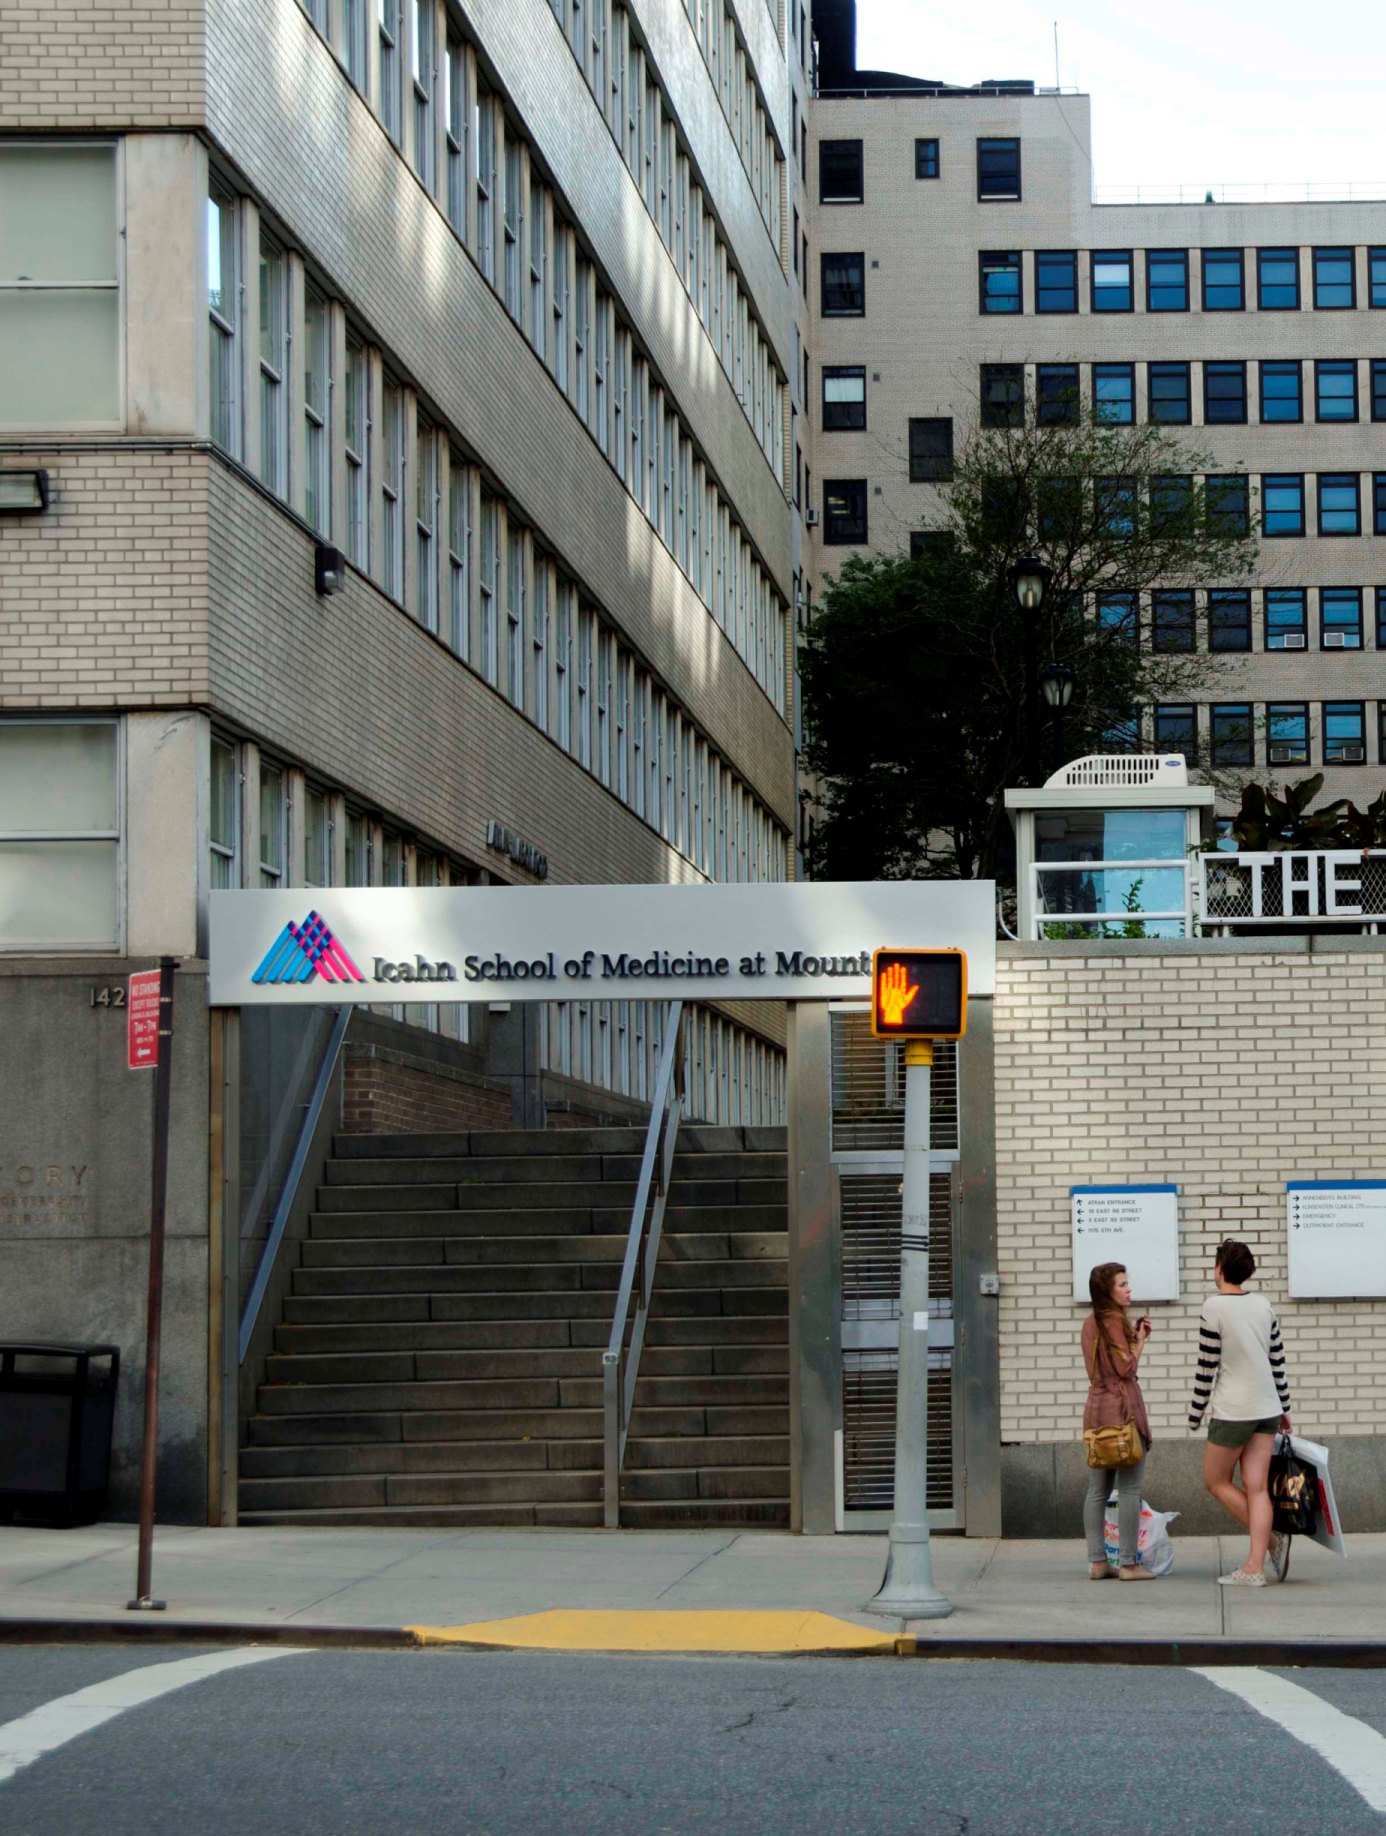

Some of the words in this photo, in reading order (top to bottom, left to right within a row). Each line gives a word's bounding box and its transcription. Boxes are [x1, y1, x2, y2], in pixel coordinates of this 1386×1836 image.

[1239, 854, 1362, 917] THE
[372, 953, 457, 982] Icahn
[464, 953, 557, 981] School
[564, 951, 595, 979] of
[601, 951, 730, 978] Medicine
[739, 952, 766, 976] at
[775, 951, 872, 977] Mount
[90, 987, 125, 1006] 142
[0, 1165, 87, 1186] ORY
